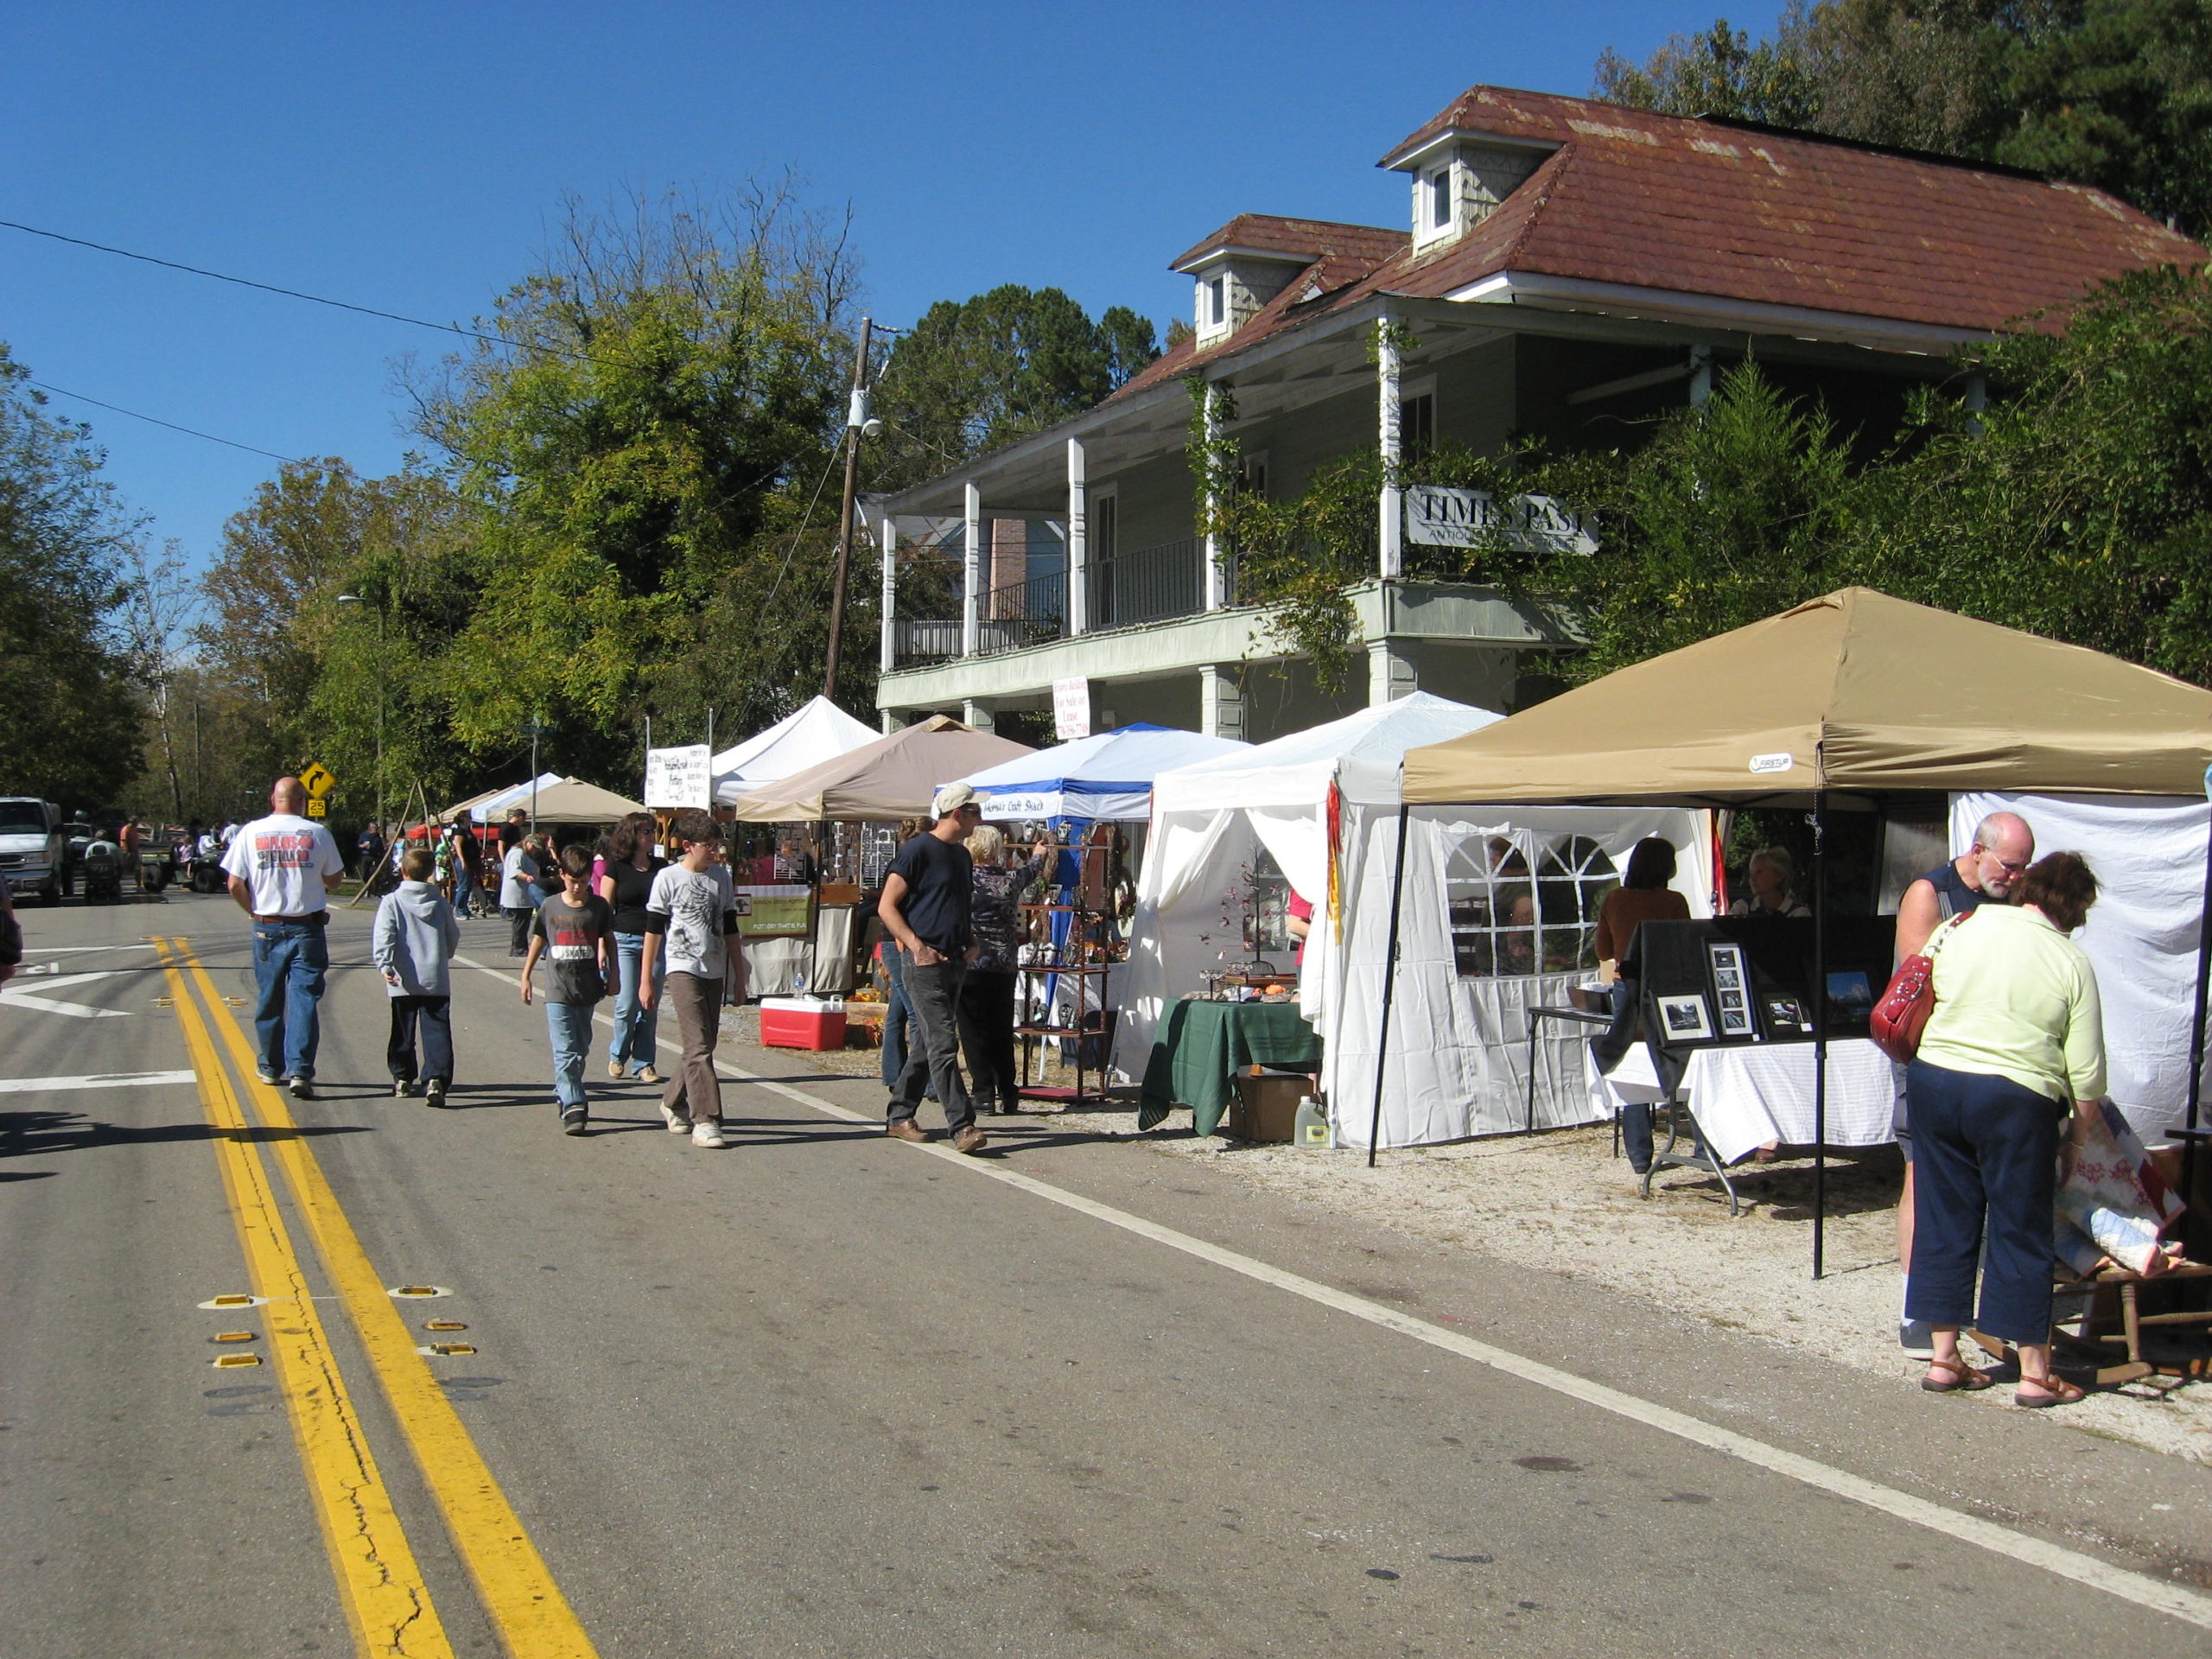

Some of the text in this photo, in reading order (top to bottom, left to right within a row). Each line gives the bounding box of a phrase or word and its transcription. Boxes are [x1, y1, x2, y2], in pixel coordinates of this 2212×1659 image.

[1065, 694, 1077, 708] Sale
[1063, 710, 1077, 722] Lease
[310, 802, 324, 810] 25
[1007, 800, 1021, 811] Craft
